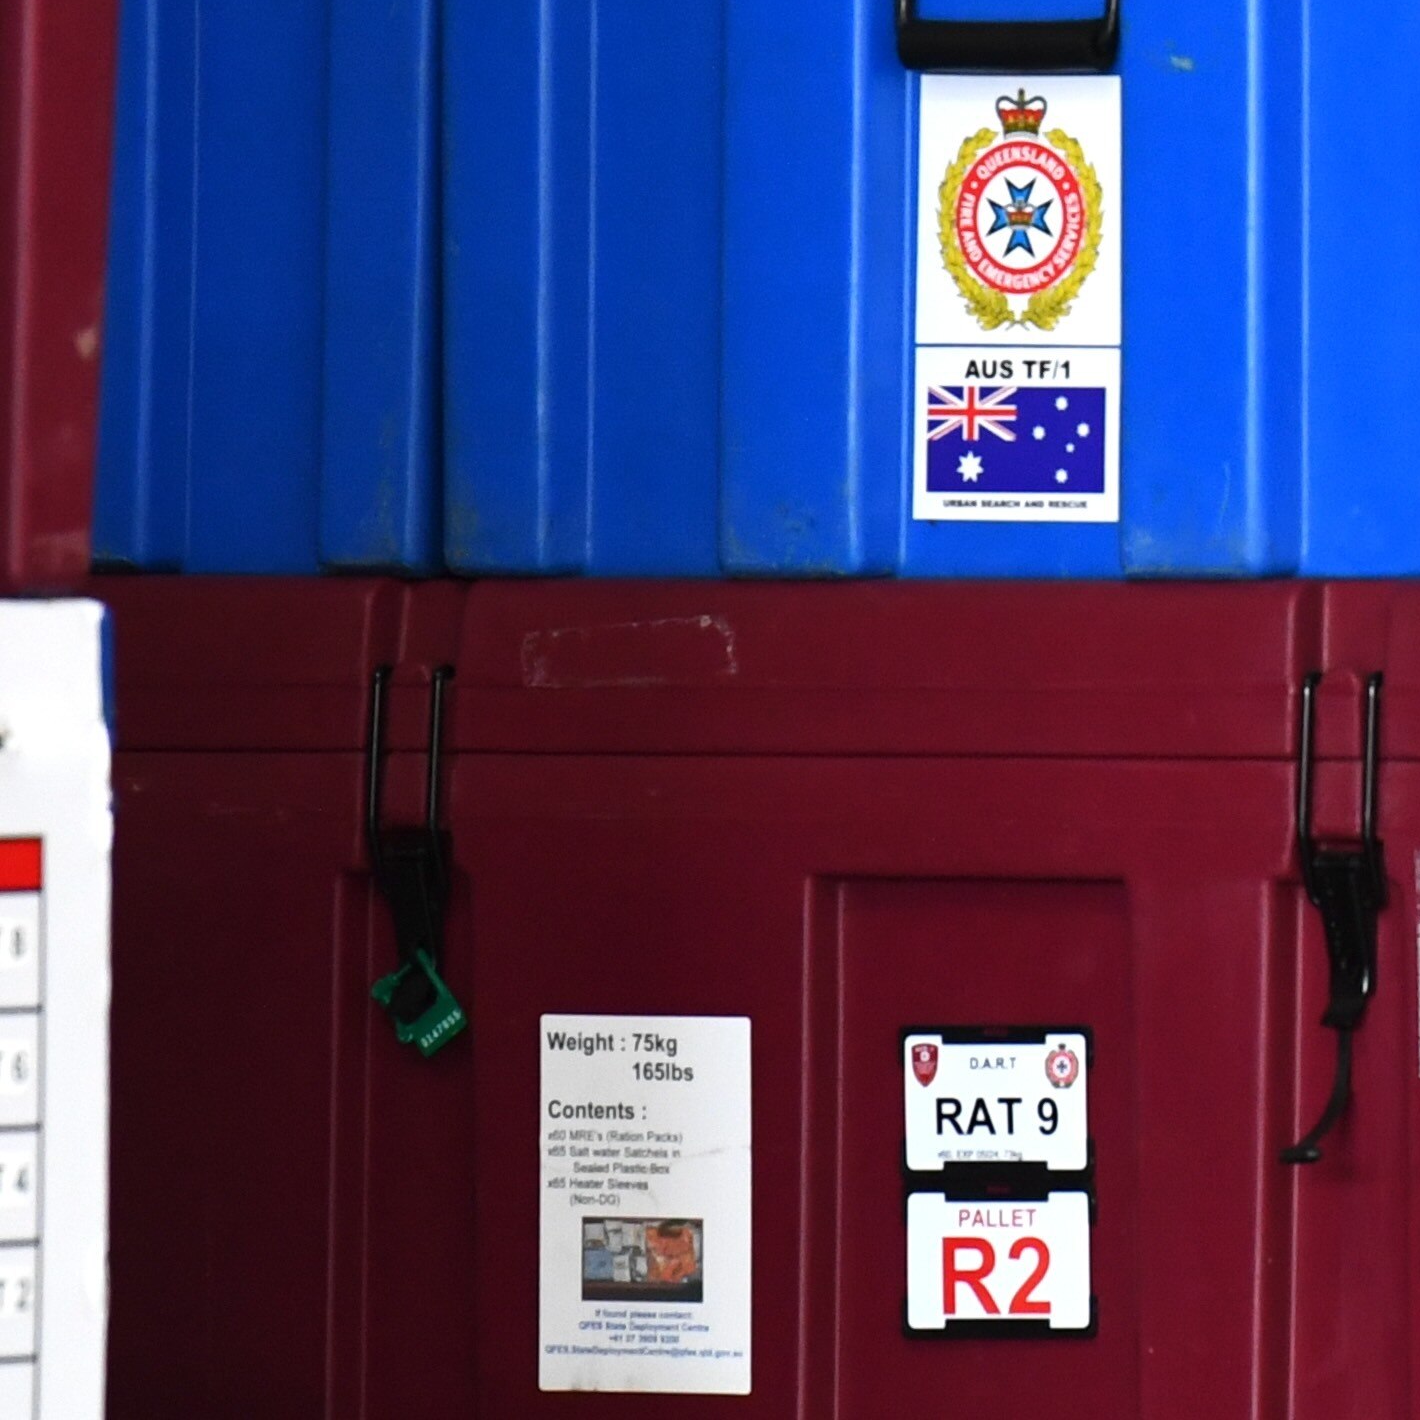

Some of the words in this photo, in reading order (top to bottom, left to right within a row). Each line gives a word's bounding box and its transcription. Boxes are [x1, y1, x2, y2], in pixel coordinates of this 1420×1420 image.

[975, 145, 1066, 180] QUEENSLAND
[959, 192, 976, 228] FIRE
[962, 230, 982, 263] AND
[1053, 192, 1079, 268] SERVICES
[976, 257, 1057, 291] EMERGENCY
[965, 359, 1014, 379] AUS
[1022, 359, 1070, 380] TF/1
[943, 499, 978, 508] URBAN
[981, 499, 1021, 508] SEARCH
[1024, 500, 1045, 508] AND
[1048, 500, 1088, 509] RESCUE
[547, 1032, 615, 1056] Weight
[632, 1033, 678, 1057] 75kg
[632, 1062, 694, 1081] 165lbs
[548, 1099, 635, 1120] Contents
[936, 1097, 1023, 1135] RAT
[1036, 1097, 1059, 1136] 9
[958, 1209, 1037, 1228] PALLET
[942, 1236, 1052, 1315] R2
